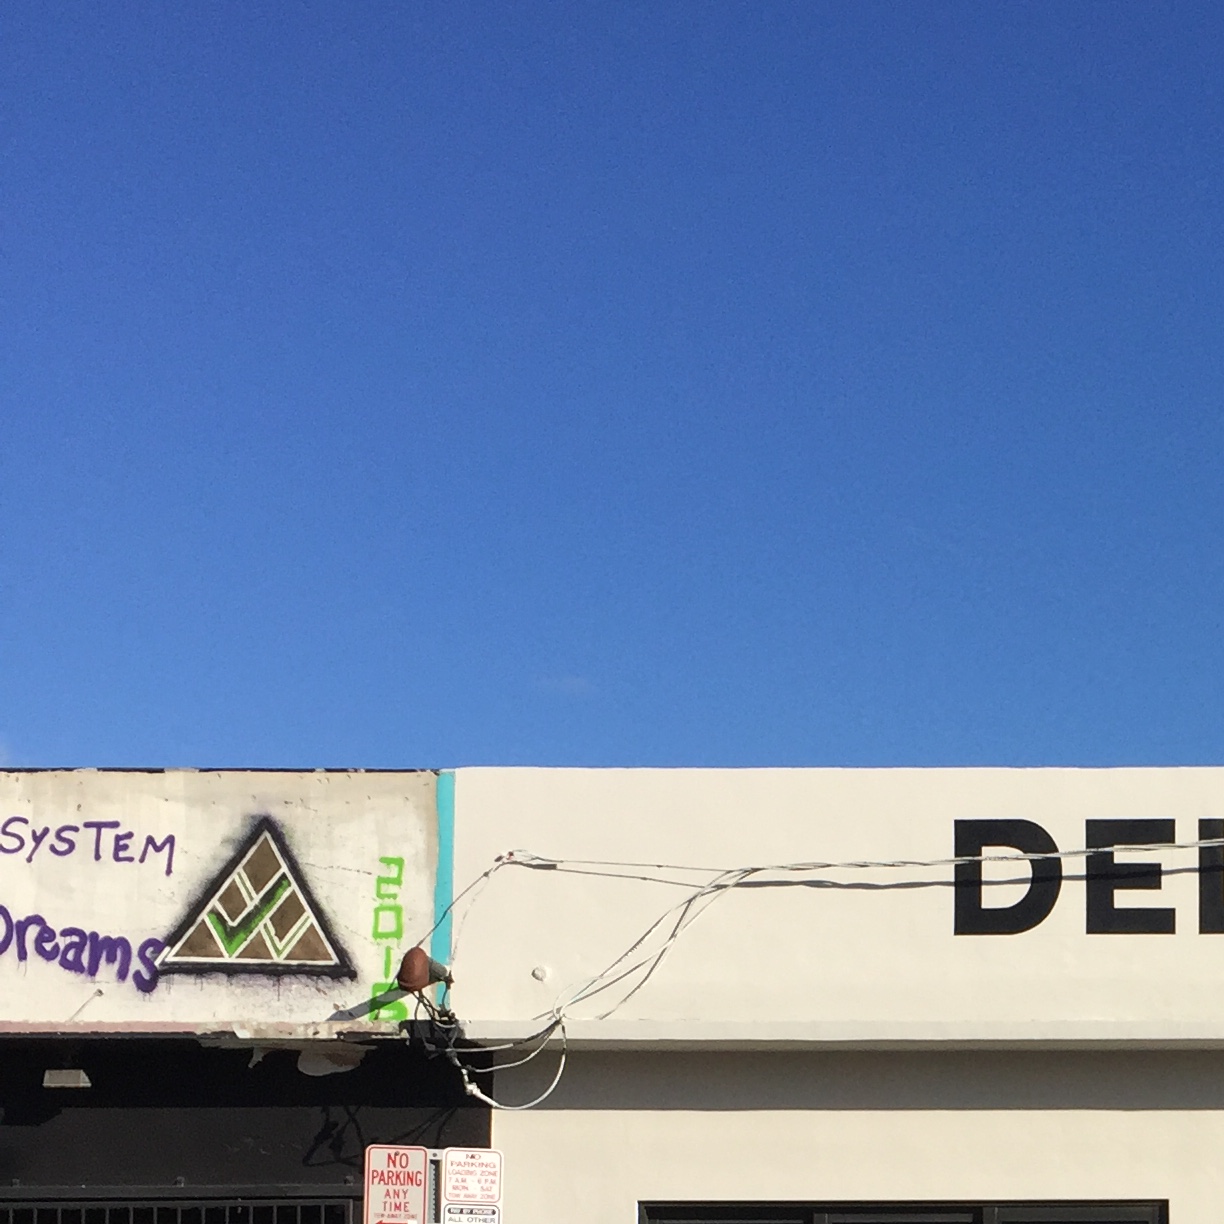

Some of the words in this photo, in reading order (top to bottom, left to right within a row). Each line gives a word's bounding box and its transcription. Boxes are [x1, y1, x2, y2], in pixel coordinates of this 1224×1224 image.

[387, 1152, 409, 1169] NO
[450, 1160, 497, 1169] PARKING
[371, 1169, 423, 1187] PARKING
[384, 1188, 409, 1200] ANY
[382, 1200, 410, 1213] TIME
